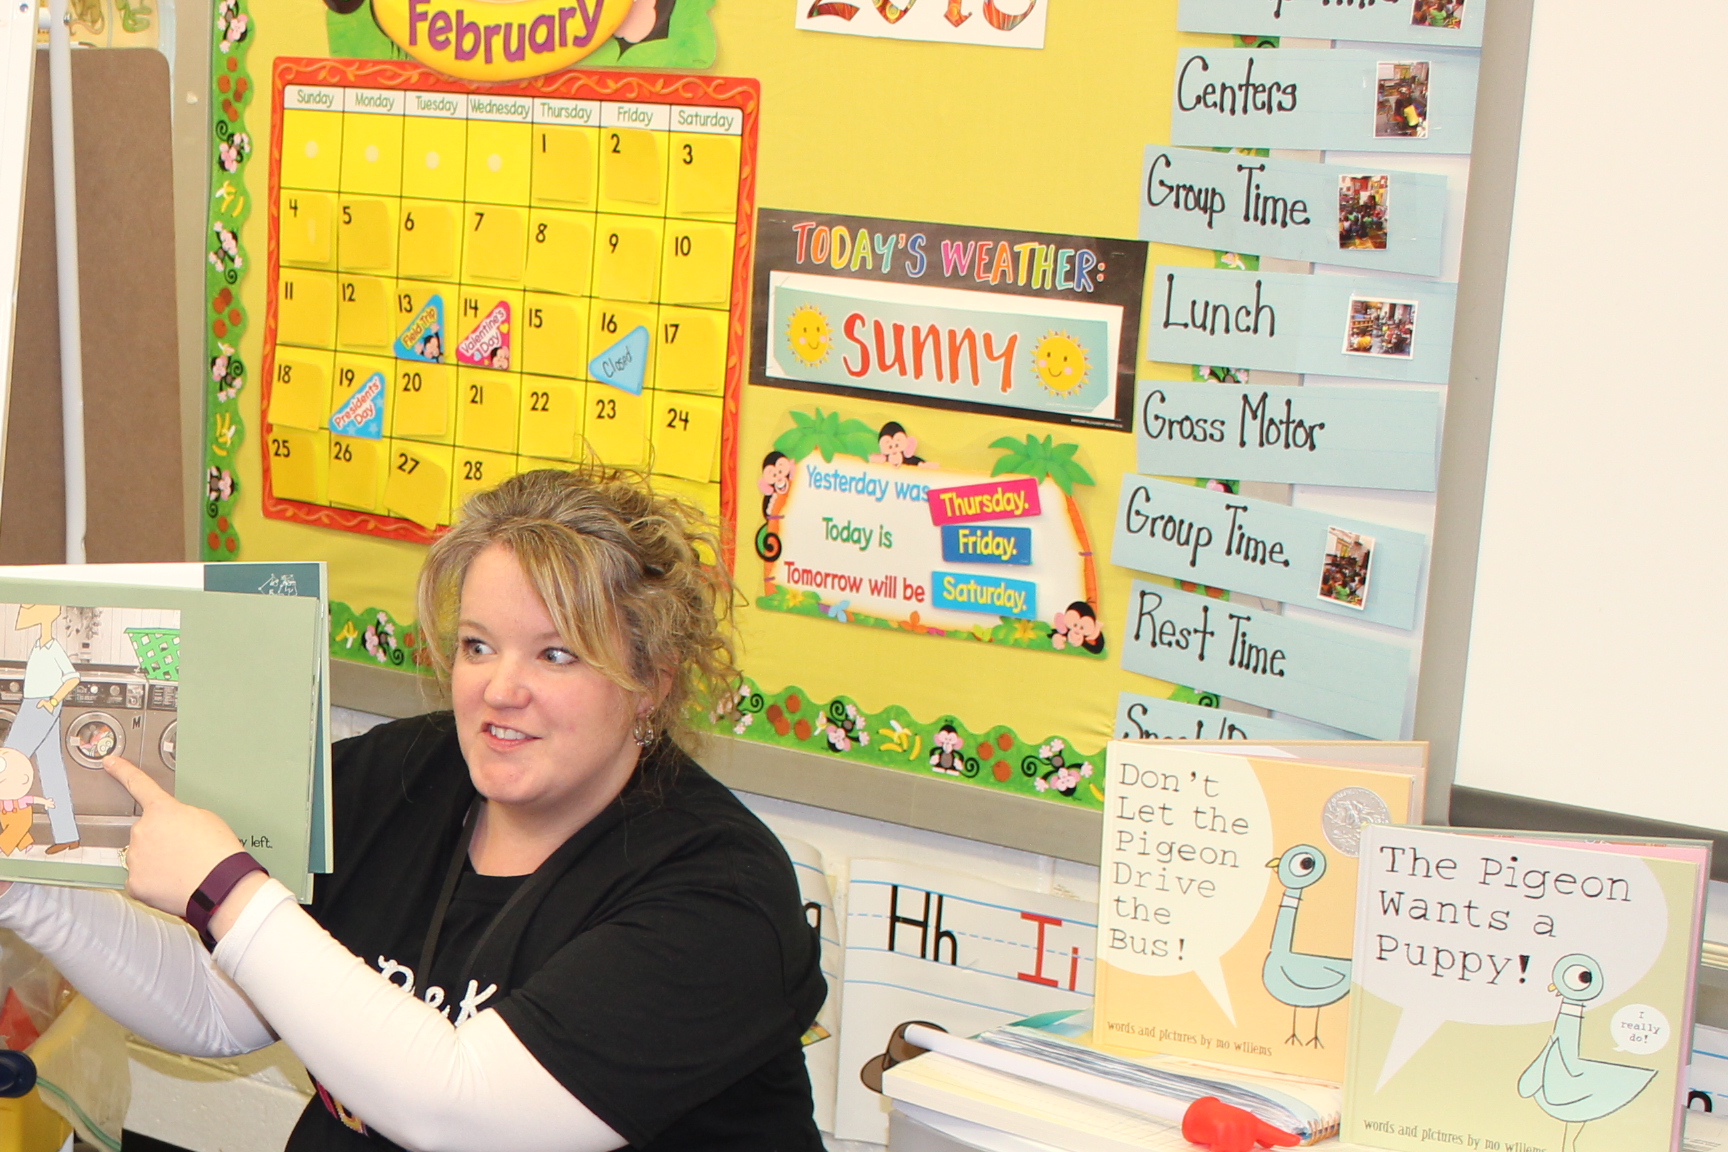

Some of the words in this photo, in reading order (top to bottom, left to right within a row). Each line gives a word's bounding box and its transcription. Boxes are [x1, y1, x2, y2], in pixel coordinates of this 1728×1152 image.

[407, 0, 605, 64] February
[1177, 55, 1298, 116] Centers
[296, 89, 334, 108] Sunday
[354, 91, 395, 112] Monday
[415, 95, 459, 115] Tuesday
[470, 99, 530, 119] Wednesday
[539, 101, 592, 123] Thursday
[616, 108, 654, 128] Friday
[677, 110, 734, 130] Saturday
[540, 134, 546, 154] 1
[610, 134, 621, 154] 2
[681, 144, 694, 166] 3
[1147, 153, 1226, 229] Group
[1237, 163, 1311, 229] Time
[288, 199, 298, 219] 4
[341, 206, 352, 225] 5
[404, 212, 415, 232] 6
[473, 213, 485, 232] 7
[535, 224, 547, 244] 8
[608, 233, 619, 254] 9
[673, 236, 692, 257] 10
[792, 222, 927, 278] TODAY'S
[941, 239, 1105, 292] WEATHER:
[284, 282, 294, 300] 11
[341, 282, 356, 302] 12
[397, 294, 413, 314] 13
[462, 298, 479, 318] 14
[1163, 273, 1276, 337] Lunch
[401, 323, 423, 348] Field
[419, 308, 437, 328] Trip
[527, 308, 544, 329] 15
[601, 312, 618, 334] 16
[461, 309, 505, 353] Valentine's
[663, 323, 679, 344] 17
[479, 332, 501, 353] Day
[842, 311, 1018, 393] Sunny
[277, 364, 292, 384] 18
[602, 350, 633, 379] Closed
[339, 368, 355, 388] 19
[402, 372, 422, 392] 20
[469, 385, 484, 405] 21
[530, 391, 550, 412] 22
[354, 404, 374, 424] Day
[595, 399, 616, 420] 23
[666, 408, 690, 431] 24
[1142, 389, 1226, 443] Gross
[1239, 391, 1326, 452] Motor
[272, 439, 291, 459] 25
[333, 442, 352, 462] 26
[398, 454, 420, 475] 27
[463, 461, 483, 481] 28
[807, 464, 889, 501] Yesterday
[895, 483, 930, 501] was
[940, 488, 1030, 517] Thursday.
[822, 517, 874, 551] Today
[878, 524, 893, 547] is
[958, 529, 1018, 556] Friday.
[1125, 486, 1213, 567] Group
[1225, 503, 1291, 568] Time
[783, 560, 863, 593] Tomorrow
[868, 575, 897, 600] will
[903, 576, 926, 603] be
[942, 575, 1027, 613] Saturday.
[1134, 590, 1215, 662] Rest
[1228, 613, 1287, 677] Time
[1119, 762, 1220, 798] Don't
[1116, 796, 1174, 826] Let
[1193, 805, 1249, 835] the
[251, 835, 273, 849] left.
[1116, 830, 1240, 868] Pigeon
[1113, 861, 1217, 898] Drive
[1380, 846, 1457, 880] The
[1479, 856, 1631, 901] Pigeon
[1114, 896, 1171, 925] the
[1379, 890, 1511, 931] Wants
[1532, 913, 1557, 938] a
[1109, 928, 1186, 961] Bus!
[1375, 934, 1531, 986] Puppy!
[1621, 1021, 1660, 1035] really
[1629, 1033, 1648, 1044] do!
[1107, 1021, 1136, 1034] words
[1138, 1026, 1156, 1038] and
[1159, 1029, 1197, 1044] pictures
[1201, 1035, 1213, 1049] by
[1216, 1038, 1230, 1049] mo
[1233, 1042, 1272, 1057] willems
[1363, 1119, 1395, 1134] words
[1398, 1125, 1418, 1138] and
[1421, 1128, 1463, 1145] pictures
[1467, 1134, 1481, 1150] by
[1485, 1139, 1500, 1151] mo
